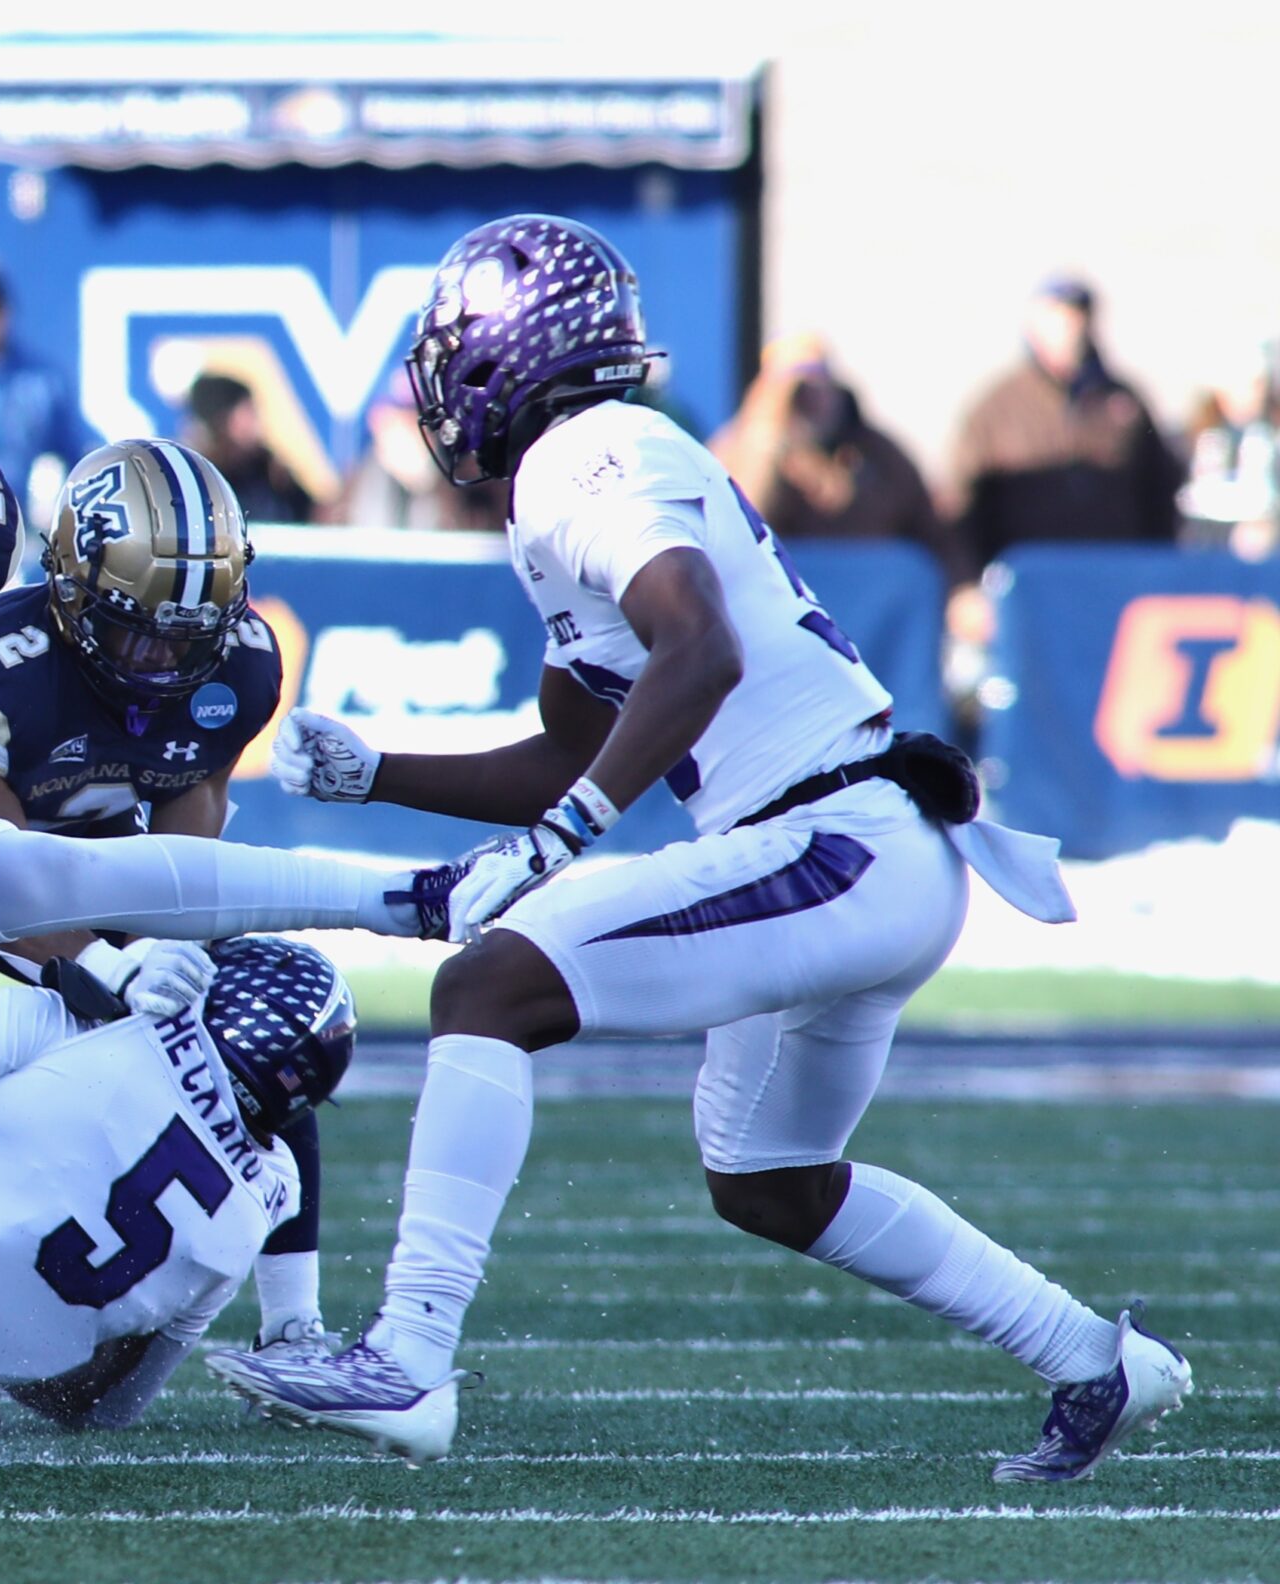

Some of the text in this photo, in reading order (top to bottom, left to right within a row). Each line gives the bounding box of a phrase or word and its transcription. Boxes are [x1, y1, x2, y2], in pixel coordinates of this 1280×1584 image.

[196, 704, 234, 718] NCAA
[28, 763, 208, 800] MONTANA STATE
[34, 1113, 234, 1310] 5
[264, 1176, 287, 1226] JR
